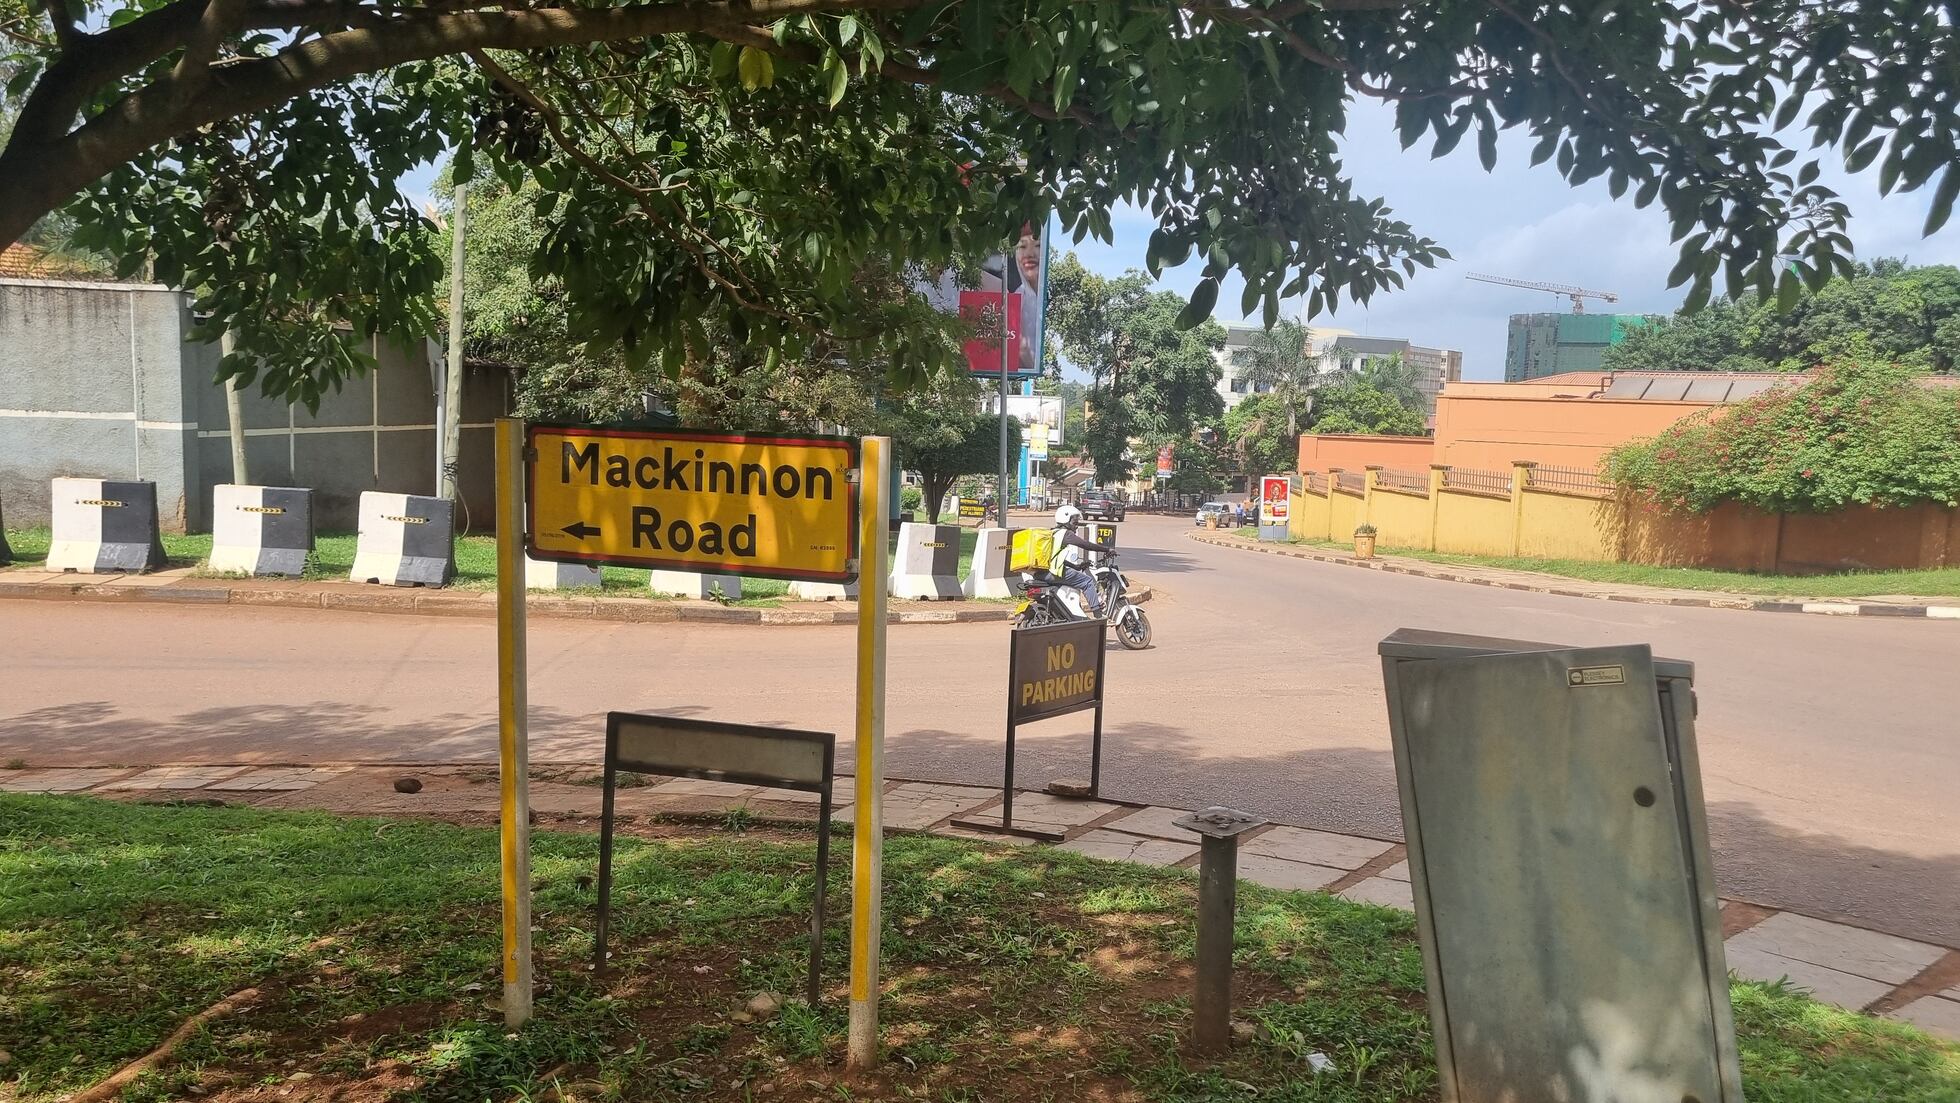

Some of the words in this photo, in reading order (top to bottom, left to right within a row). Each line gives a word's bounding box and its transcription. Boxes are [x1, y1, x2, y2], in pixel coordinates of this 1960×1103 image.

[561, 441, 833, 501] Mackinnon
[632, 506, 757, 558] Road
[1047, 643, 1075, 672] NO
[1022, 670, 1095, 706] PARKING
